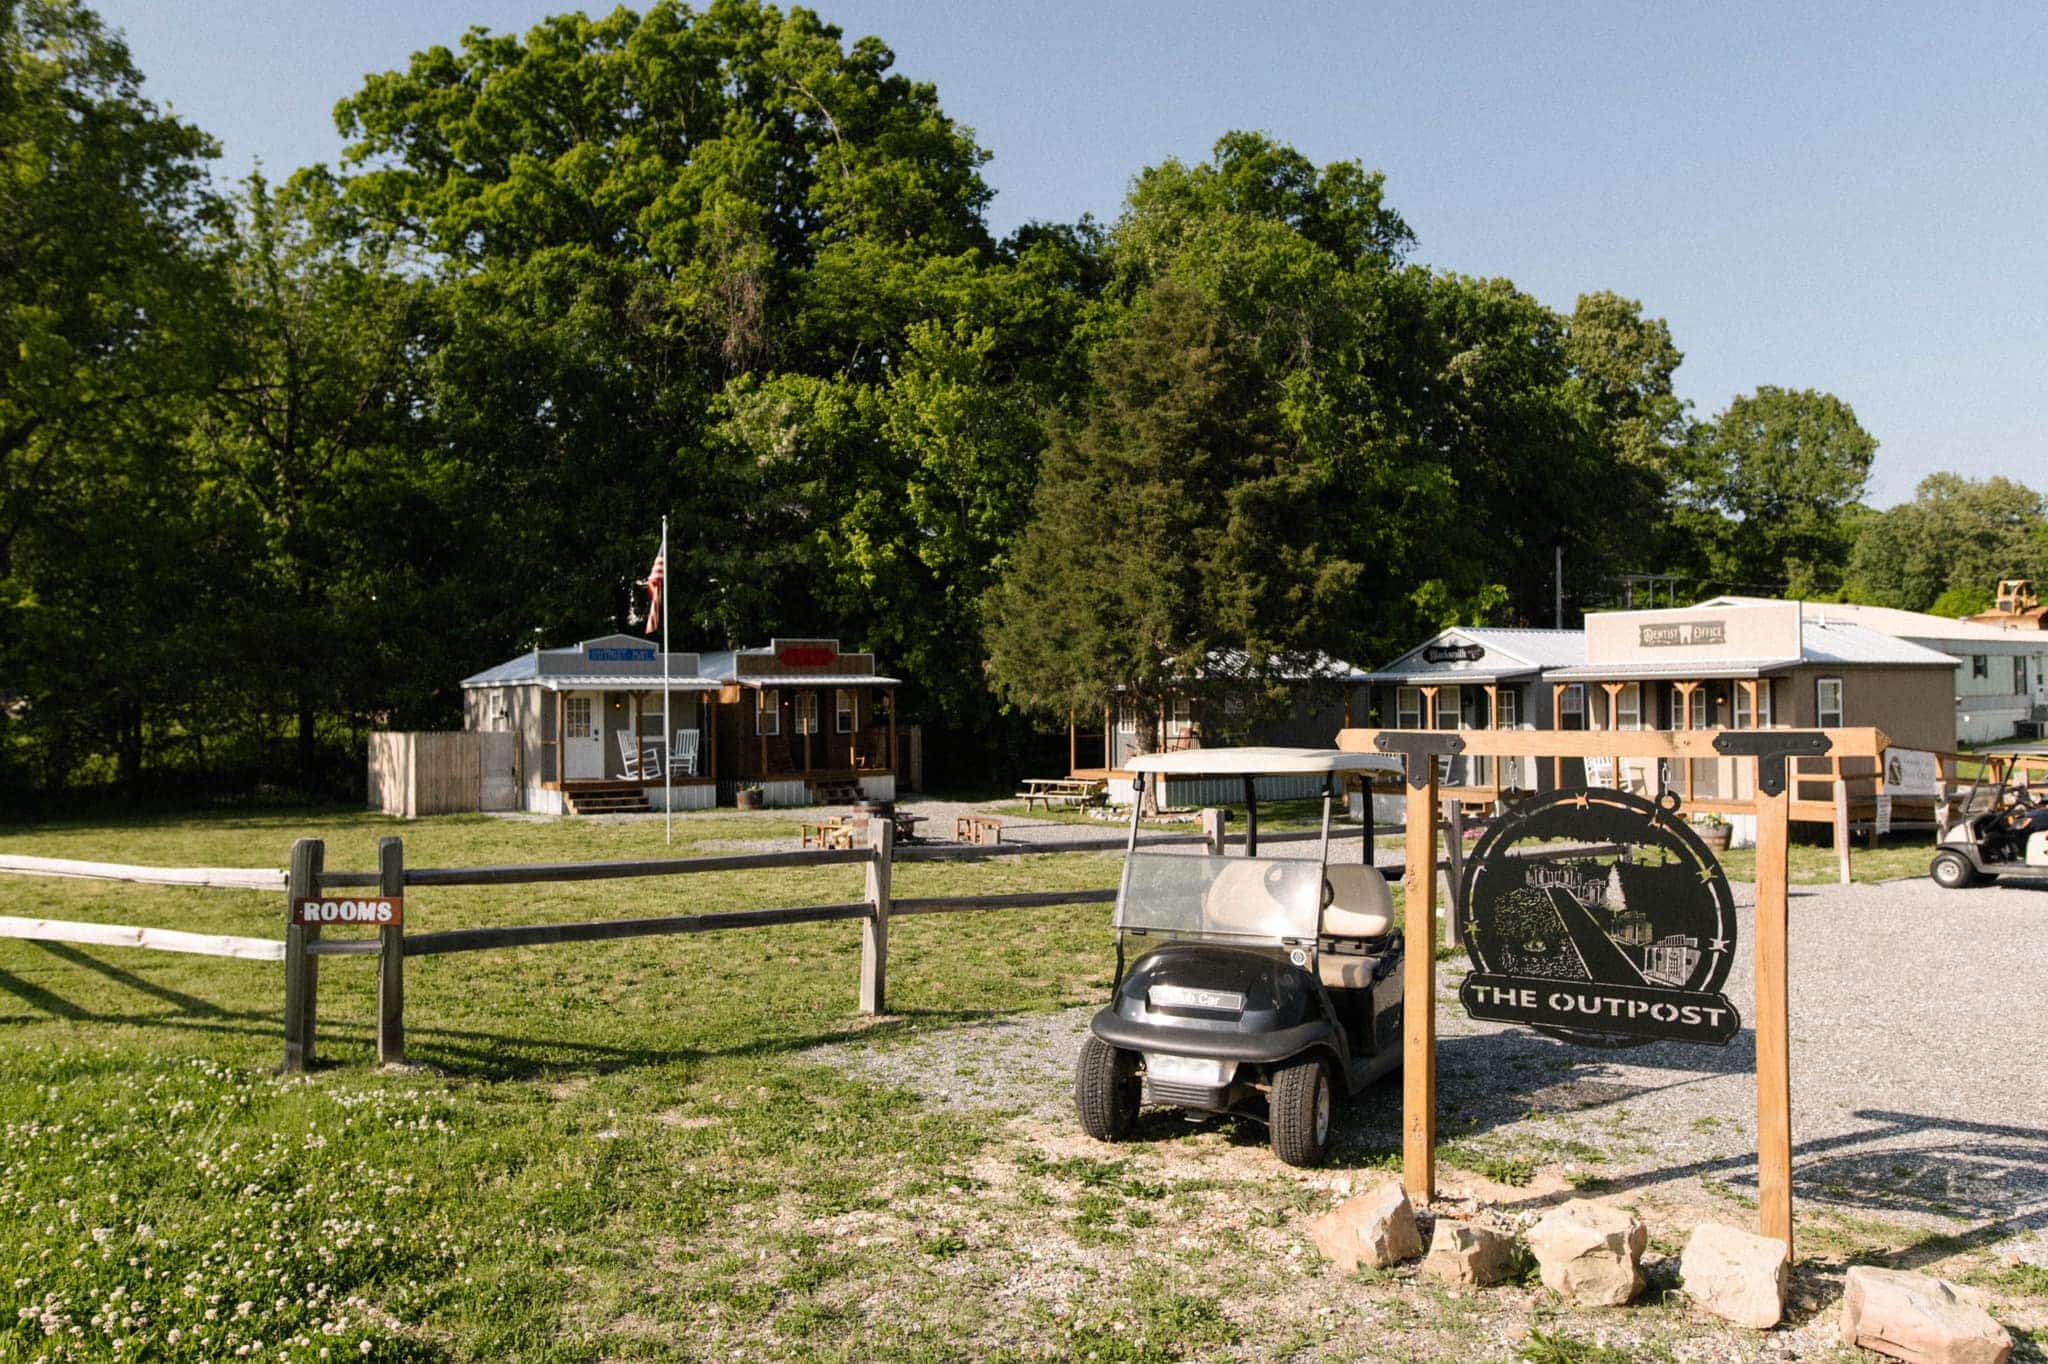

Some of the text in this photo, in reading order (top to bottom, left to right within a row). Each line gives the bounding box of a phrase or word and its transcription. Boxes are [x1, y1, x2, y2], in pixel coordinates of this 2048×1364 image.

[304, 901, 392, 921] ROOMS
[1199, 993, 1220, 1006] Car
[1470, 985, 1727, 1027] THE OUTPOST
